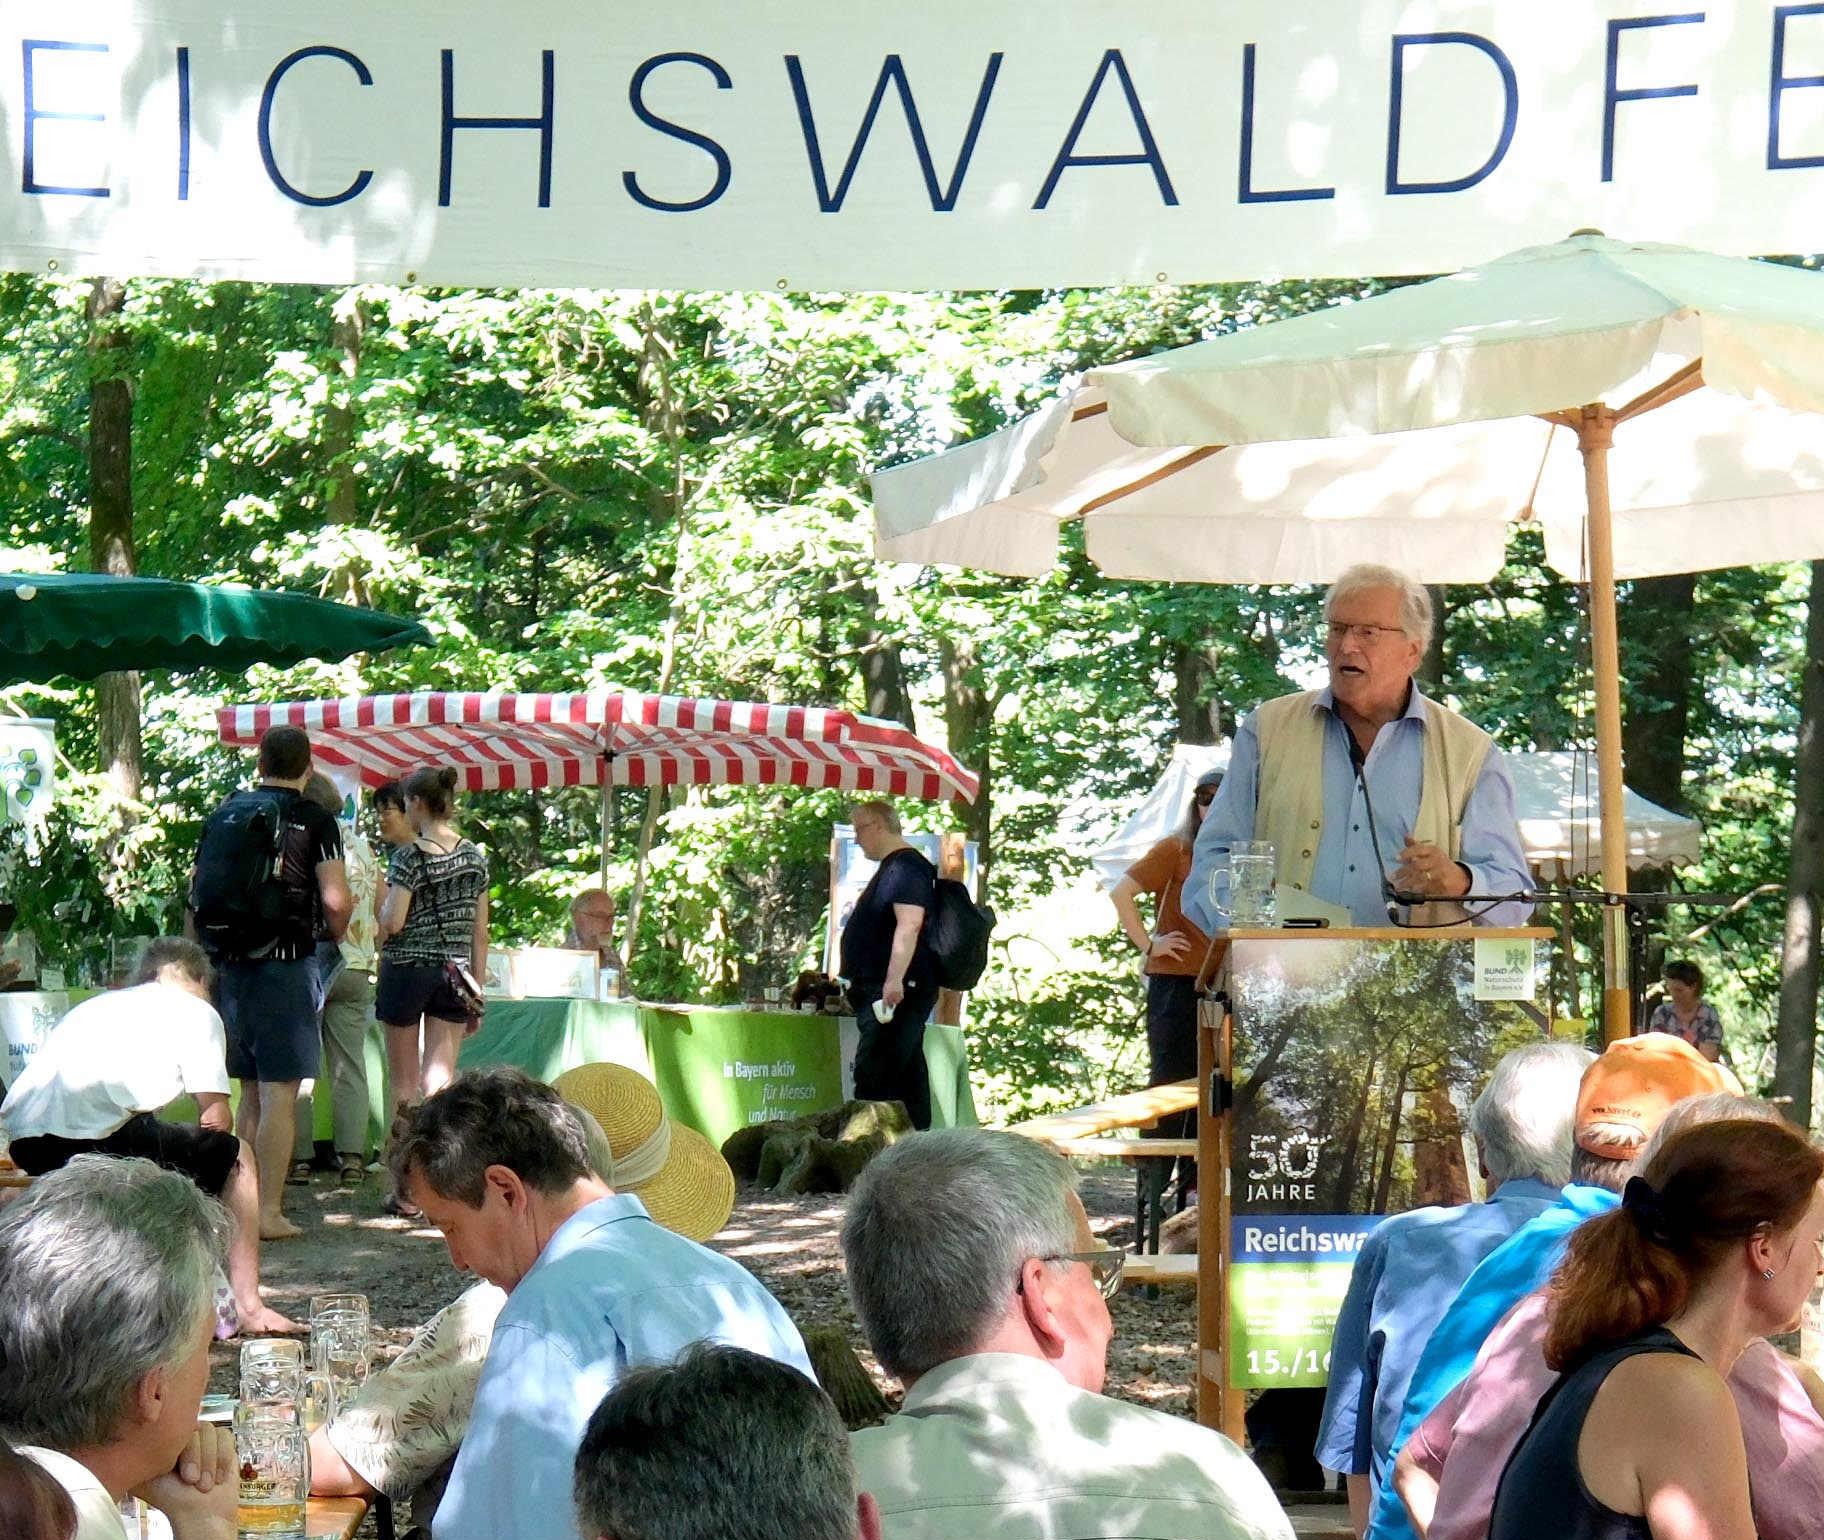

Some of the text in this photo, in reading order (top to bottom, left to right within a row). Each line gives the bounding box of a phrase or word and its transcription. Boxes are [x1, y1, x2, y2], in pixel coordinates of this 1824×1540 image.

[735, 1061, 769, 1081] Bayern
[771, 1061, 796, 1077] aktiv
[780, 1083, 817, 1100] Mensch
[1248, 1131, 1332, 1180] 50
[1247, 1184, 1317, 1203] JAHRE
